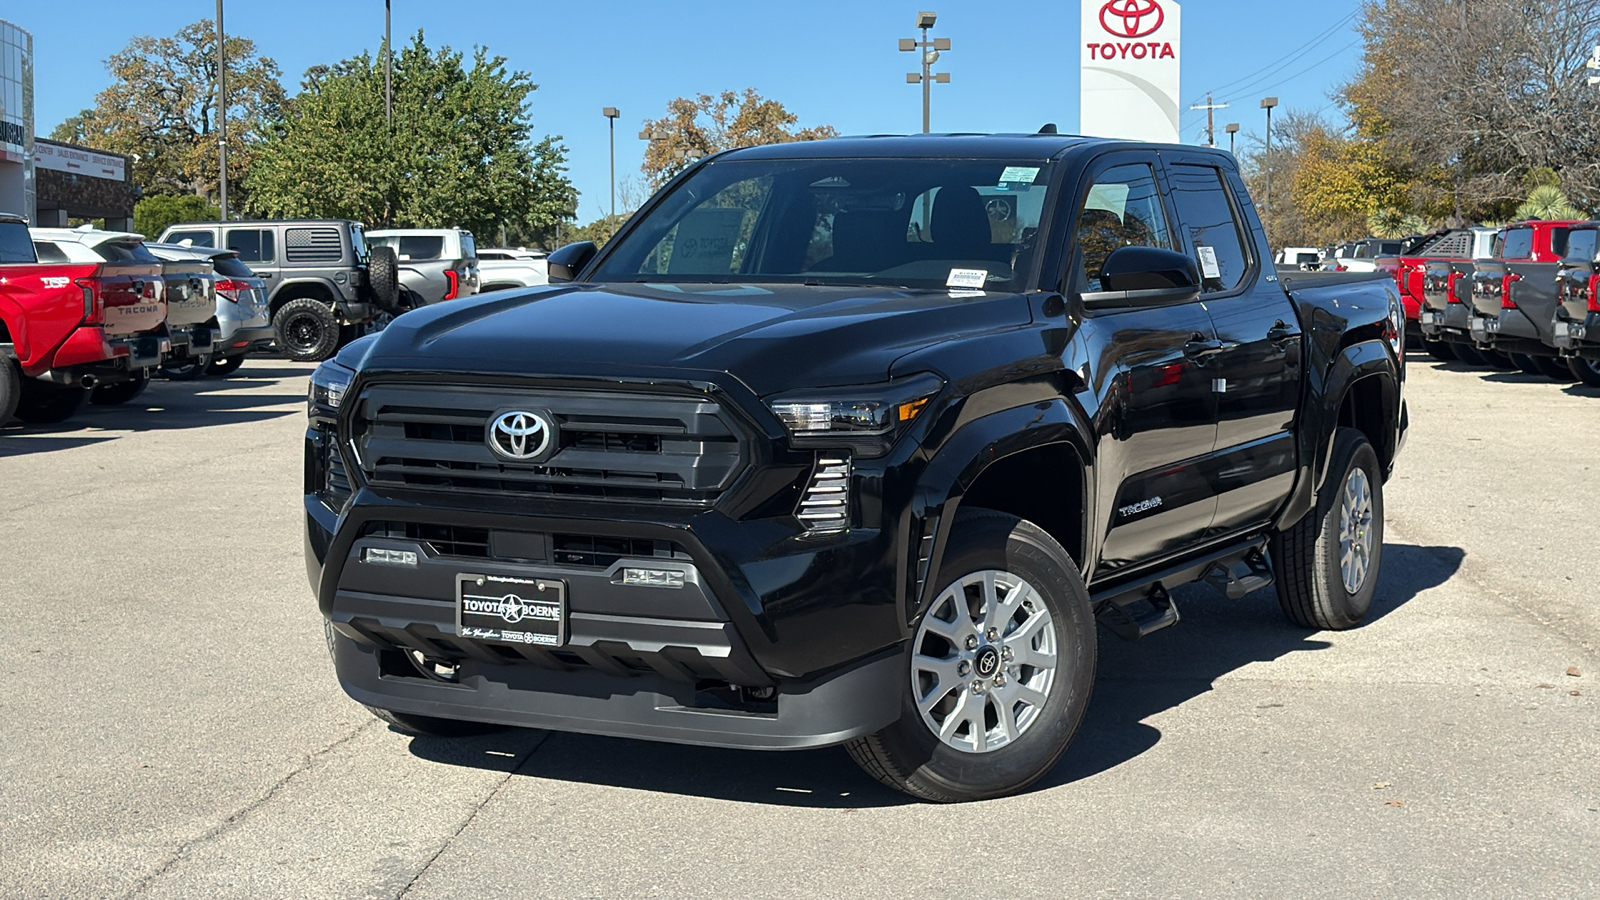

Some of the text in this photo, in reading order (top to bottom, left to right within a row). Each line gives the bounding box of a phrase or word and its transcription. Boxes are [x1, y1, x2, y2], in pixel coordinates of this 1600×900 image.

[1087, 42, 1175, 60] TOYOTA
[39, 145, 54, 155] CENTER
[58, 149, 88, 162] SALES ENTRANCE
[93, 155, 123, 168] SERVICE ENTRANCE
[118, 305, 158, 315] TACOMA
[1119, 496, 1163, 517] TACOMA
[463, 600, 560, 617] TOYOTA BOERNE
[534, 635, 557, 643] BOERNE
